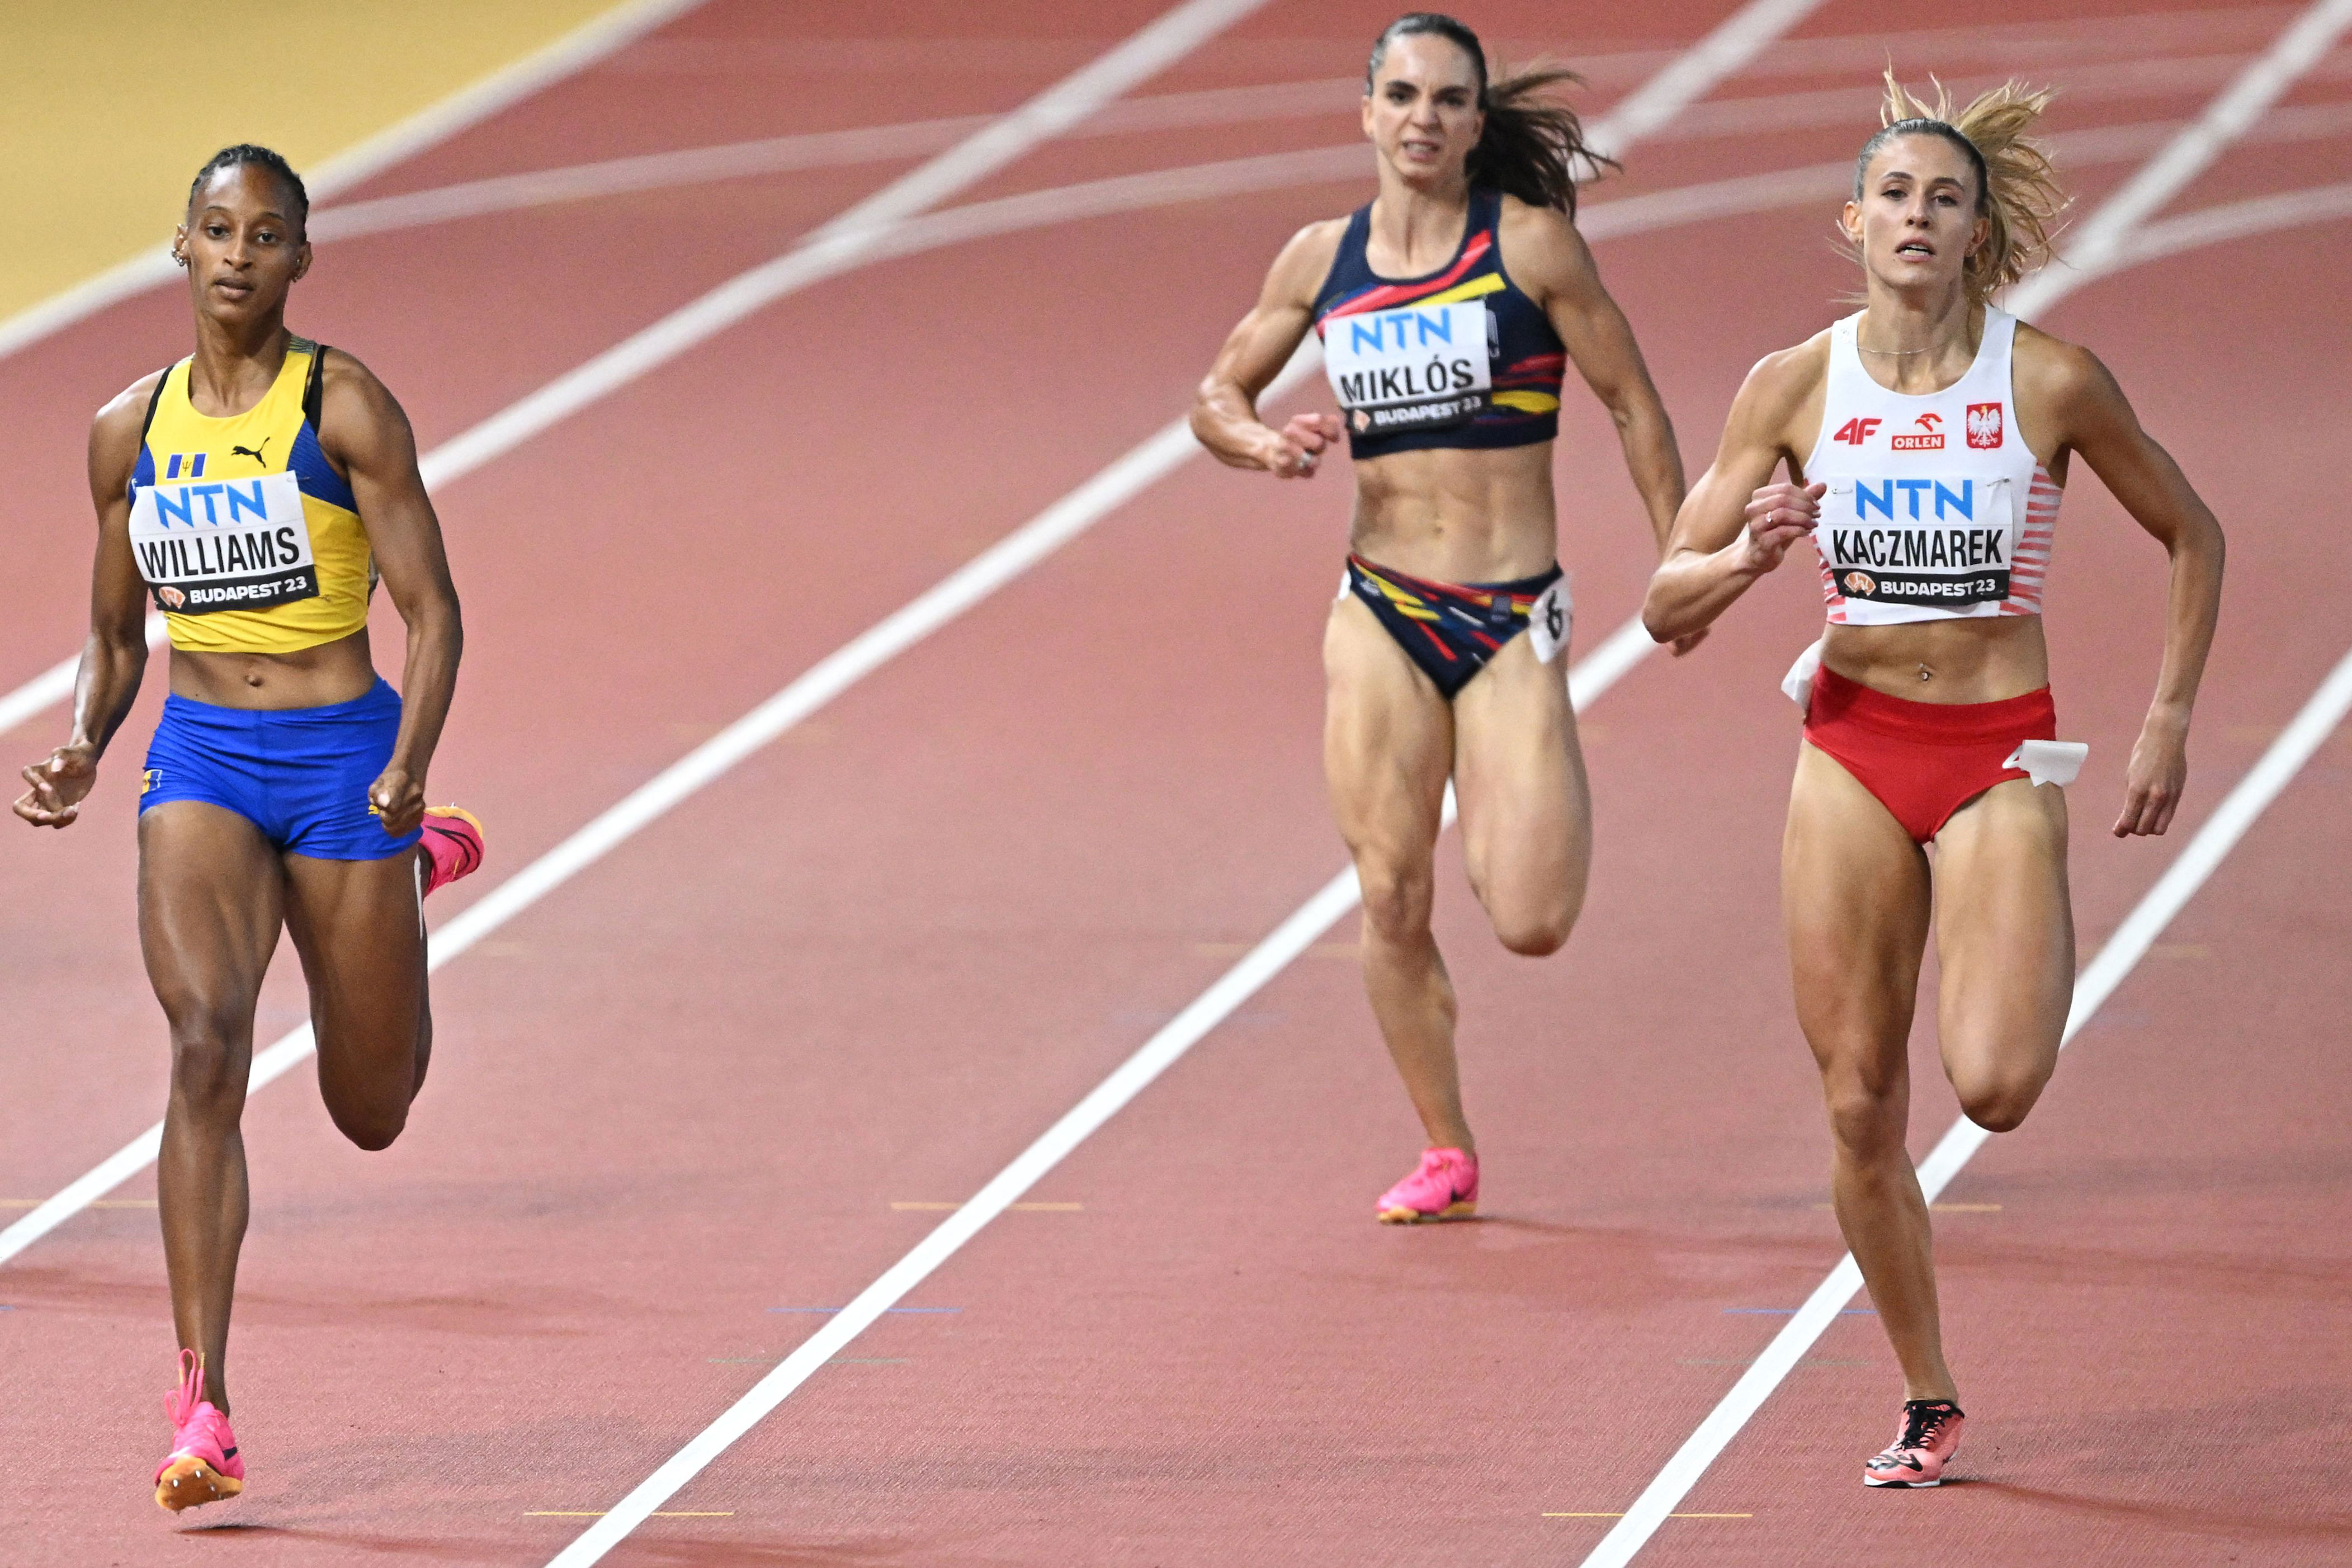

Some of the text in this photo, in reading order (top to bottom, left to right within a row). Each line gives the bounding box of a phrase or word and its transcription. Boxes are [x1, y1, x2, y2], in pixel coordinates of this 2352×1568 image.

[1351, 308, 1452, 356] NTN
[1340, 353, 1474, 403] MIKLÓS
[1375, 403, 1460, 426] BUDAPEST
[1834, 418, 1882, 445] 4F
[1894, 437, 1942, 449] ORLEN
[153, 480, 267, 530] NTN
[1855, 479, 1973, 521] NTN
[139, 526, 300, 579] WILLIAMS
[1833, 528, 2004, 568] KACZMAREK
[190, 575, 307, 604] BUDAPEST 23
[1881, 578, 1996, 597] BUDAPEST 23
[1547, 590, 1563, 640] 6
